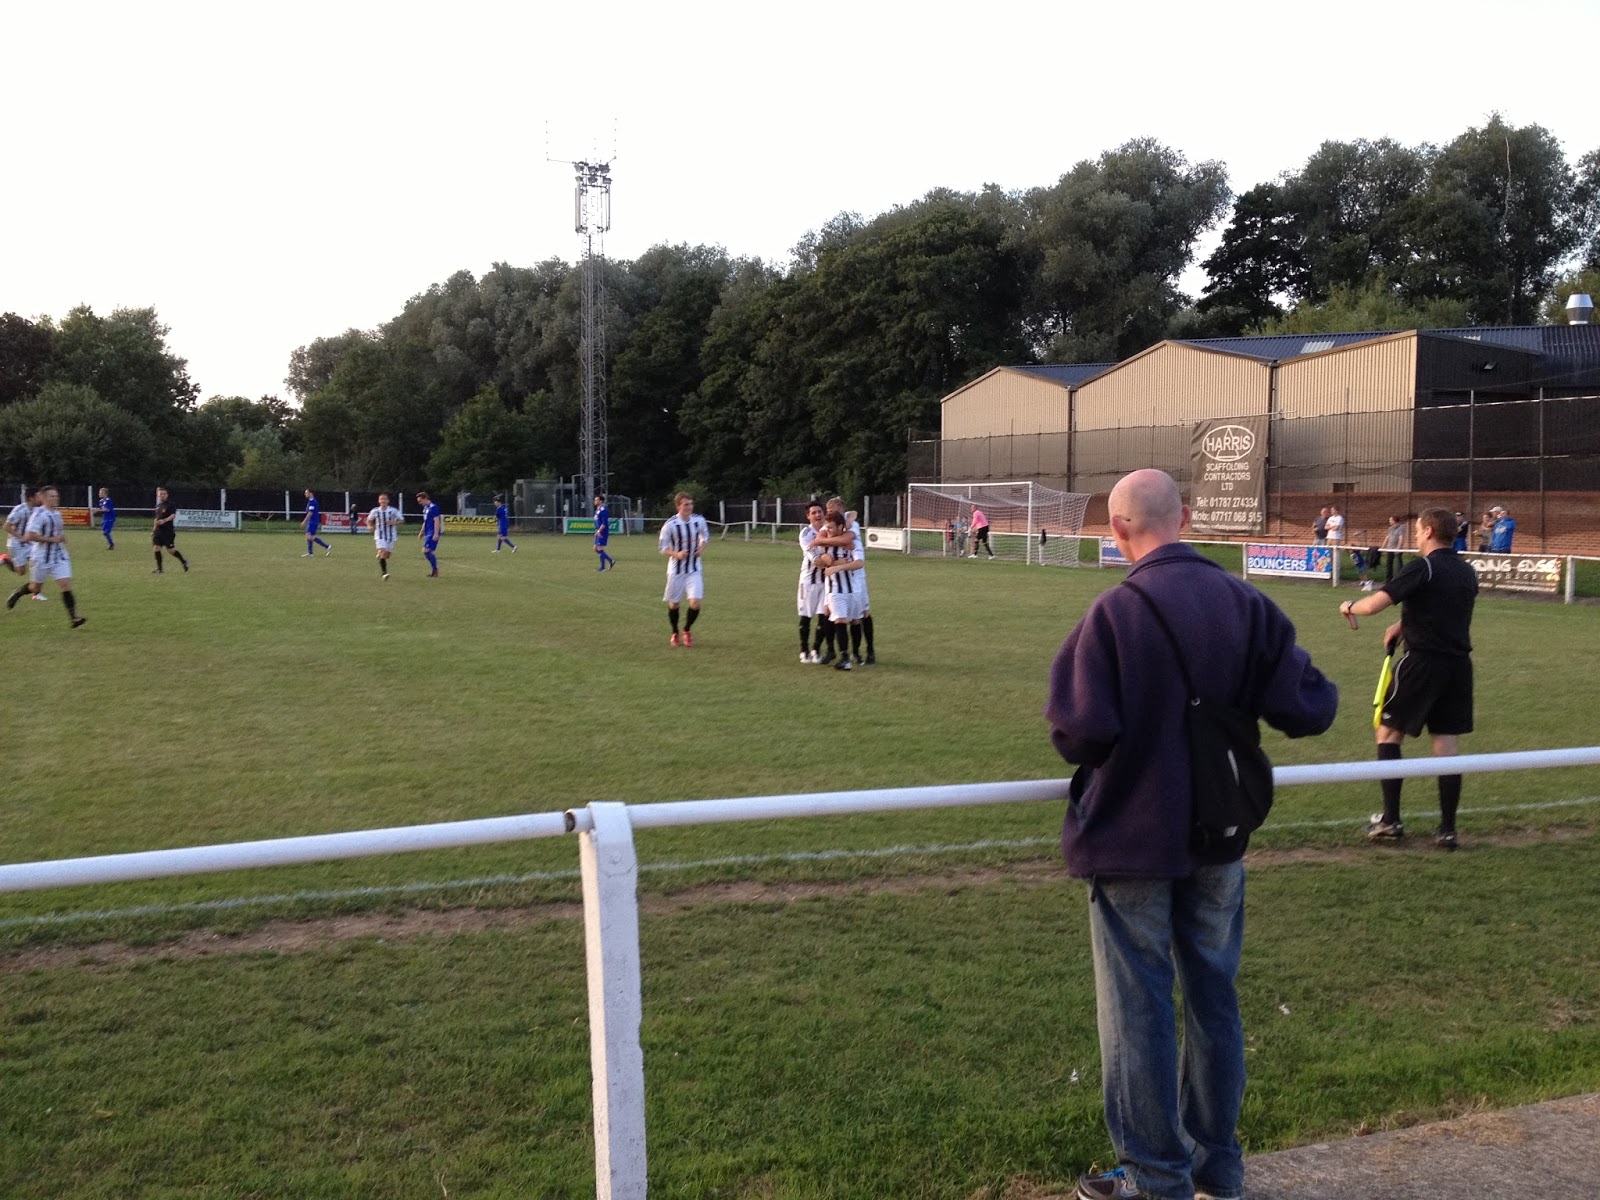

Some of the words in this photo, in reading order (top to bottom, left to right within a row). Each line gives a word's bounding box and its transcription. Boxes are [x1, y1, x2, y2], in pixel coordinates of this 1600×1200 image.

[1206, 435, 1251, 451] HARRIS
[1206, 462, 1249, 471] SCAFFOLDING
[1204, 472, 1251, 481] CONTRACTORS
[1221, 482, 1234, 491] LTD
[1209, 497, 1232, 508] 01787
[1232, 497, 1258, 508] 274334
[1210, 511, 1232, 522] 07717
[1233, 512, 1247, 522] 068
[1248, 512, 1263, 523] 515
[1248, 545, 1308, 559] BRAINTREE
[1248, 557, 1307, 571] BOUNCERS
